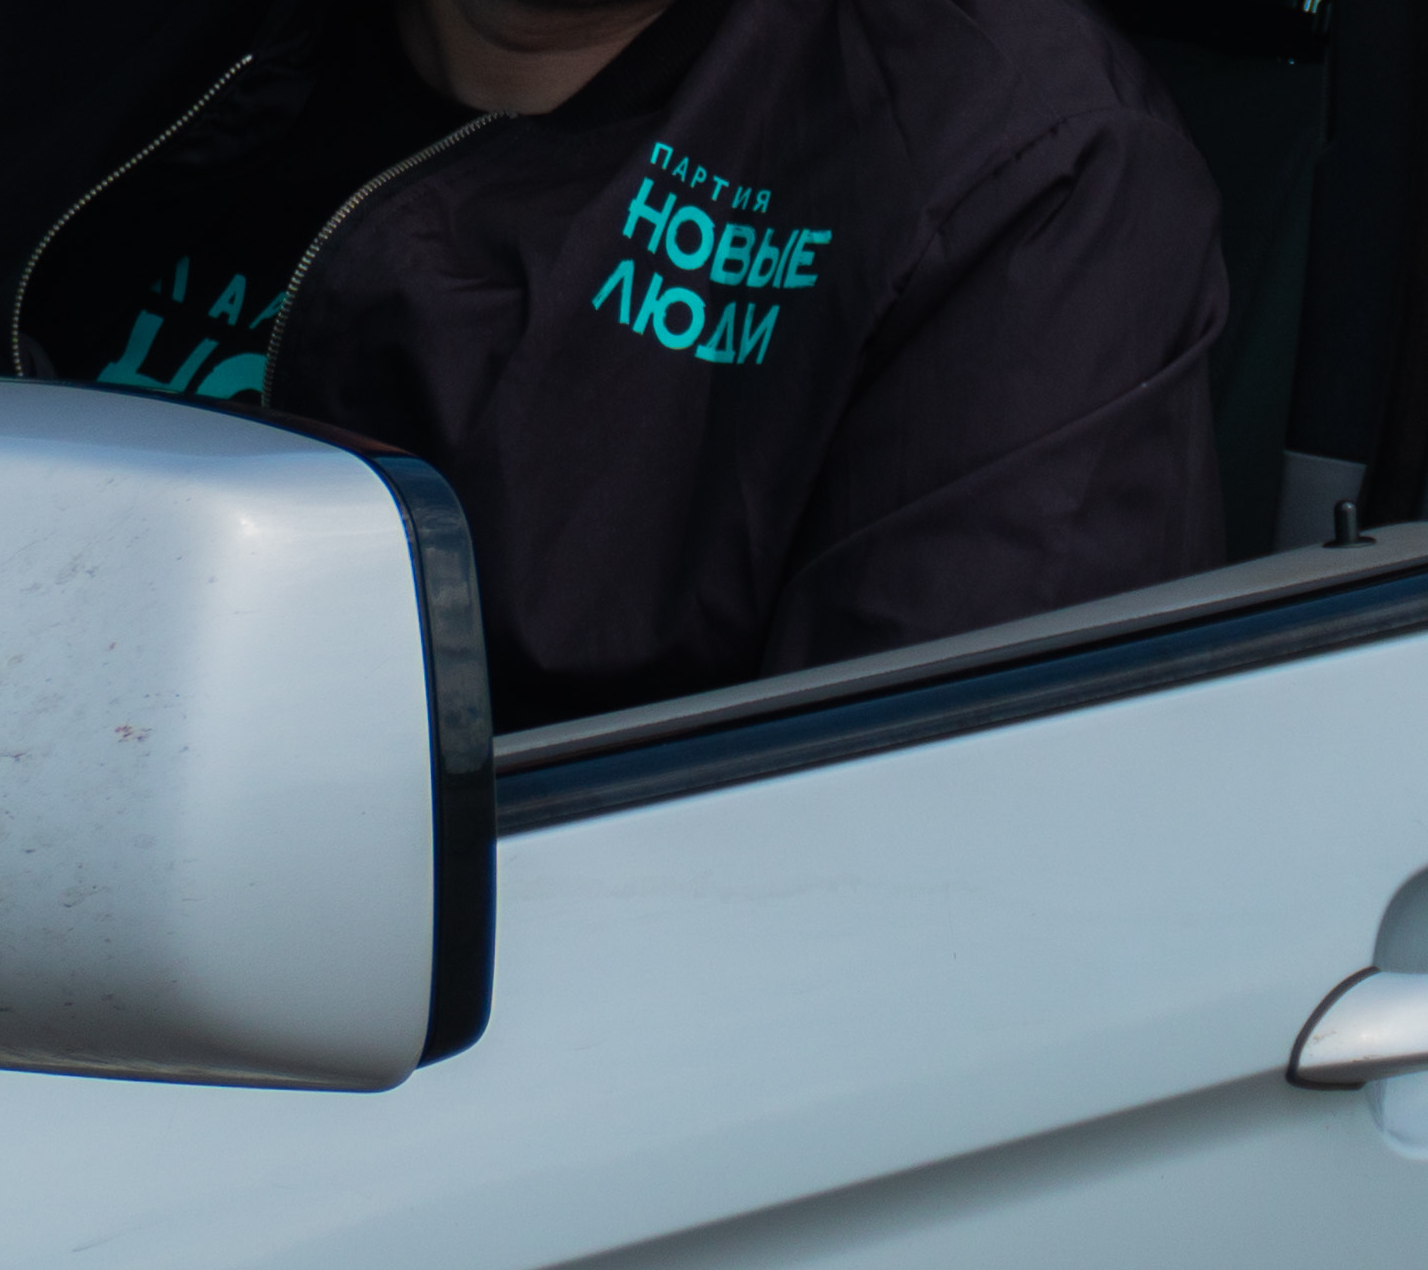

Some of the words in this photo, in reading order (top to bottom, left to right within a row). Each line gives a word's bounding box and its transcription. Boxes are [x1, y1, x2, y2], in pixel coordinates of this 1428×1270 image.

[649, 141, 772, 214] ПАРТИЯ
[622, 176, 833, 289] НОВЫЕ
[591, 258, 781, 366] ЛЮДИ
